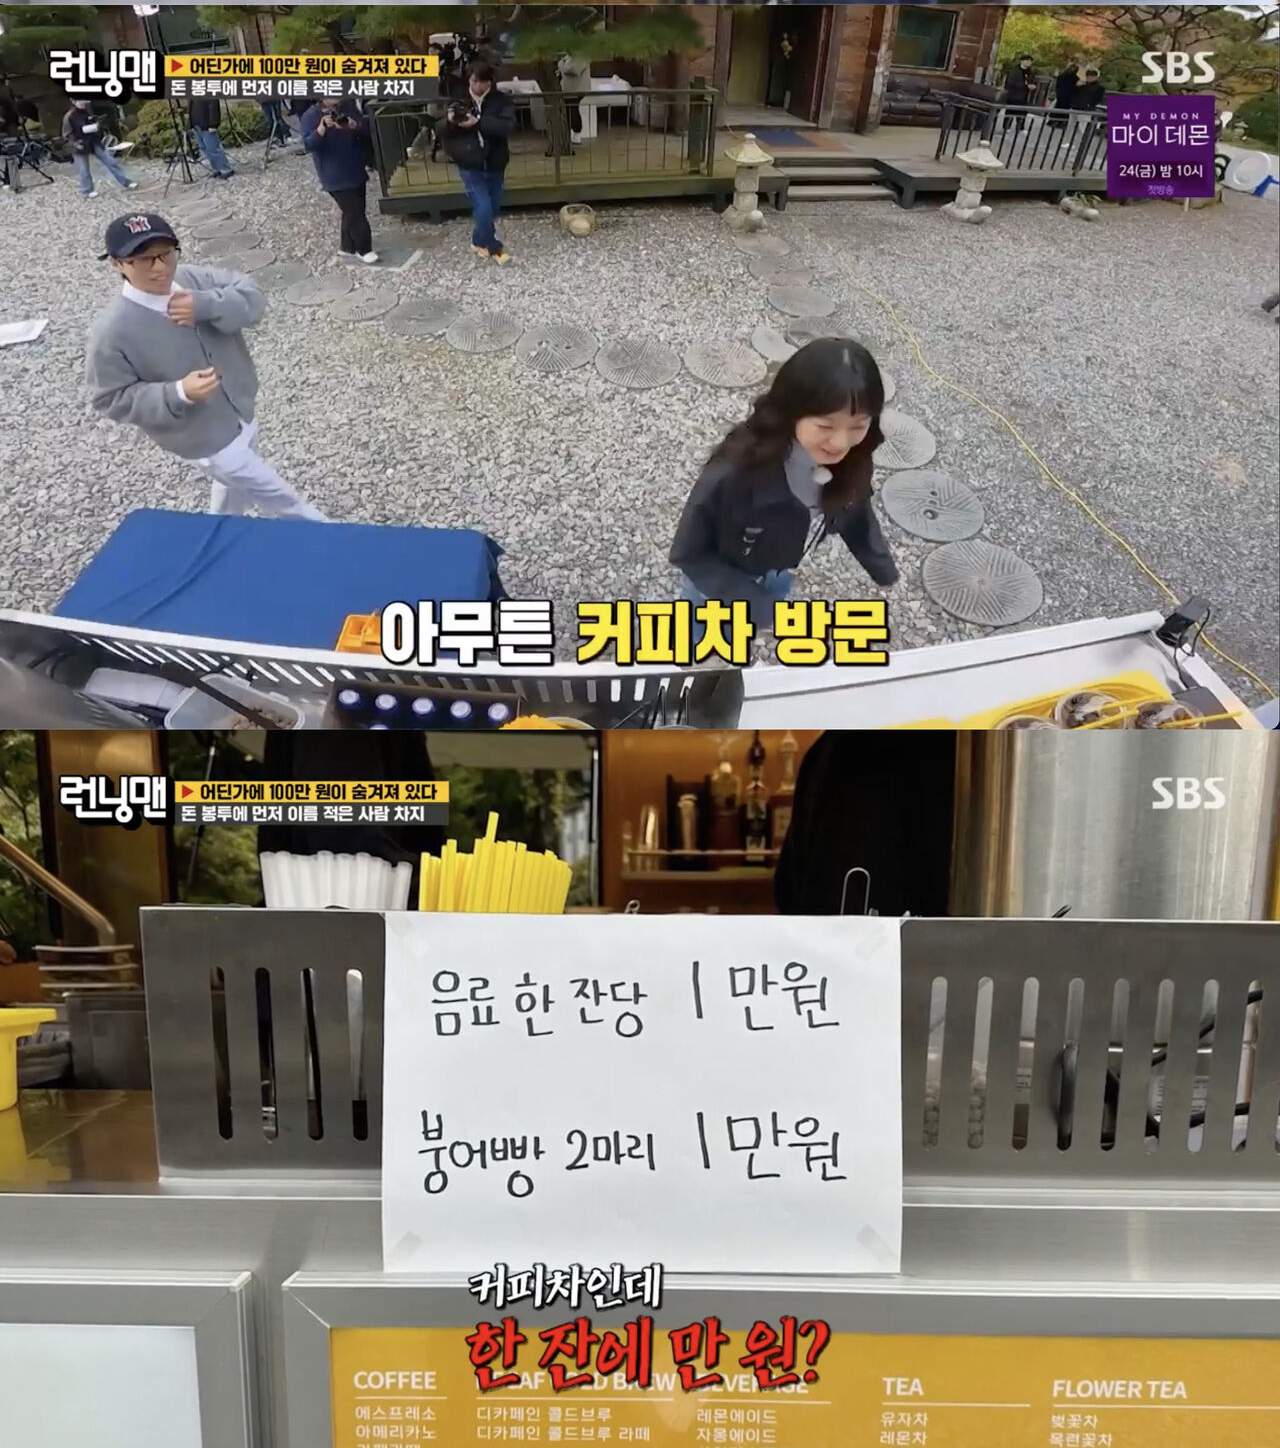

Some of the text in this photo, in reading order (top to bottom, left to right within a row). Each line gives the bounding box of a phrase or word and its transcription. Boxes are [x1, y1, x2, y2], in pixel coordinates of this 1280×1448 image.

[432, 969, 500, 1036] 음료
[514, 971, 555, 1037] 한
[569, 977, 648, 1037] 잔당
[418, 1109, 546, 1198] 붕어빵
[565, 1129, 656, 1171] 2마리
[353, 1371, 437, 1390] COFFEE
[882, 1377, 924, 1396] TEA
[1052, 1379, 1188, 1399] FLOWER TEA
[355, 1406, 437, 1421] 에스프레소
[476, 1406, 541, 1422] 디카페인
[696, 1409, 777, 1424] 레몬에이드
[880, 1412, 928, 1427] 유자차
[355, 1424, 437, 1440] 아메리카노
[476, 1425, 541, 1441] 디카페인
[696, 1427, 777, 1443] 자몽에이드
[879, 1431, 927, 1446] 레몬차
